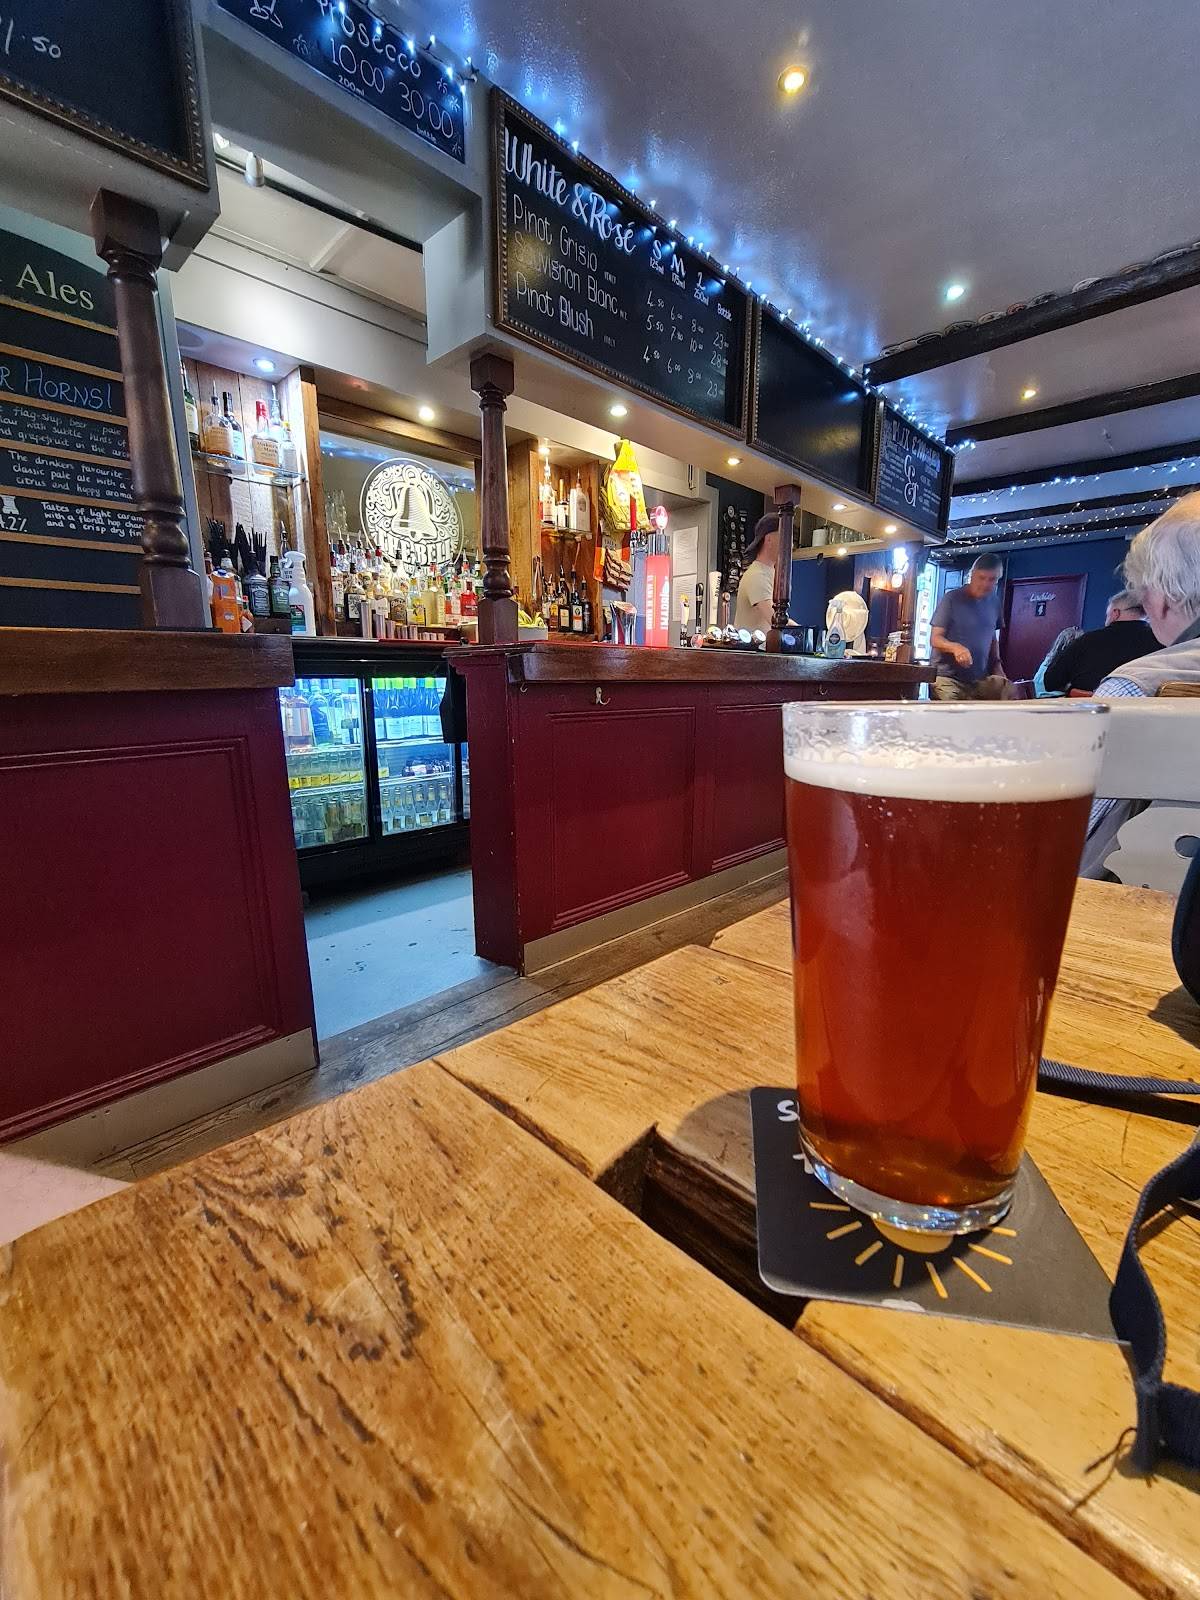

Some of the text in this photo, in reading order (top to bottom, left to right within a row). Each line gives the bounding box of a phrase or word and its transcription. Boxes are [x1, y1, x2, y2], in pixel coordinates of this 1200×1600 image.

[337, 75, 365, 96] 200ml
[504, 127, 637, 255] White & Rosé
[513, 193, 552, 245] Pinot
[560, 225, 598, 272] Grigio
[514, 231, 581, 294] Svignon
[587, 274, 618, 315] Blanc
[652, 240, 662, 260] S
[671, 254, 686, 278] M
[16, 263, 94, 311] Ales
[516, 271, 555, 318] Pinot
[559, 295, 594, 340] Blush
[24, 362, 112, 412] HORNS!
[8, 450, 28, 461] The
[81, 464, 123, 479] favourite
[13, 463, 45, 476] classic
[51, 471, 71, 480] pale
[77, 475, 91, 483] ale
[16, 477, 47, 487] citrus
[52, 482, 70, 490] and
[41, 501, 146, 522] Tastes of light caram
[44, 512, 66, 520] with
[107, 519, 121, 528] hop
[46, 520, 142, 538] and a crisp dry fin
